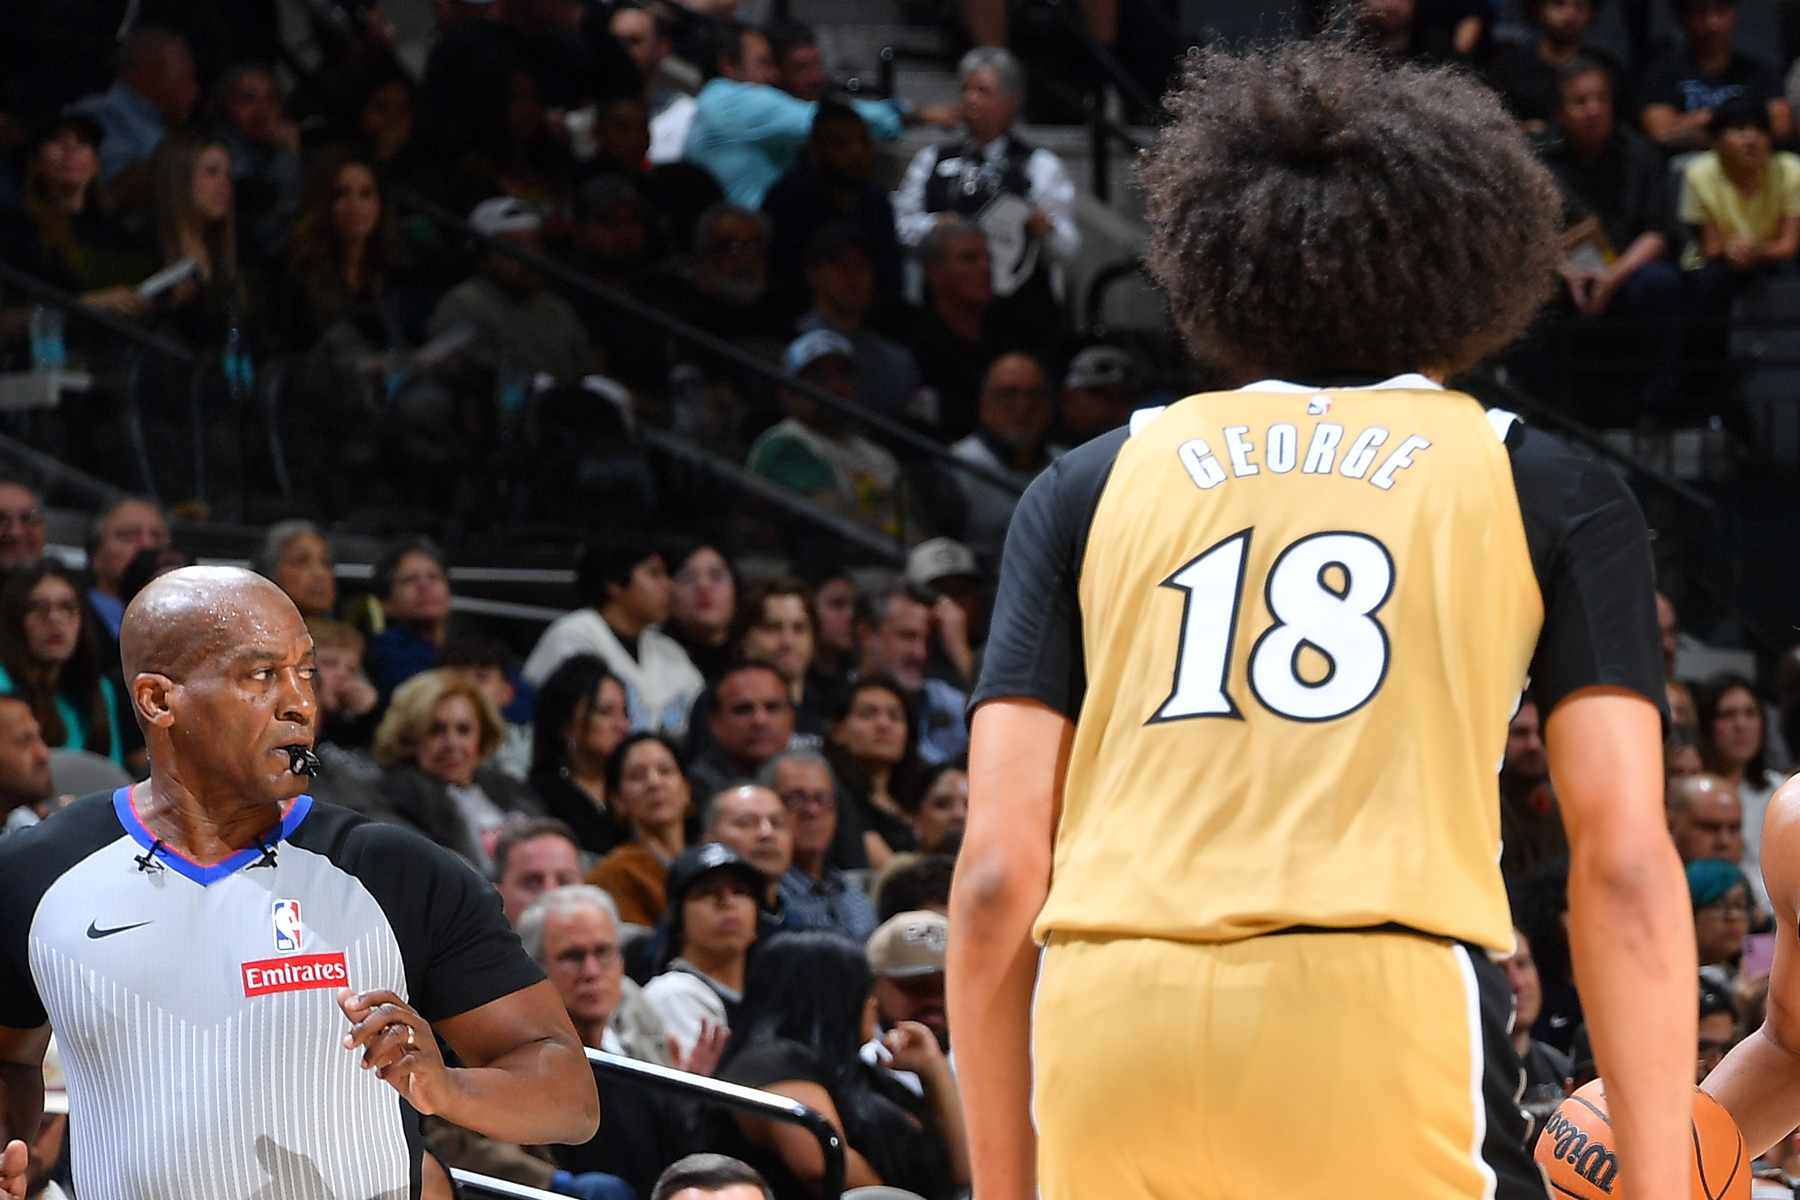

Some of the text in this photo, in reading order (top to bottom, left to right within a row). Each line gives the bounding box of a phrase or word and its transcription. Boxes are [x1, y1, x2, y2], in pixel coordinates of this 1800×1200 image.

[1177, 422, 1432, 490] GEORGE
[1143, 526, 1396, 726] 18
[245, 962, 346, 989] Emirates
[1545, 1112, 1618, 1195] Wilso
